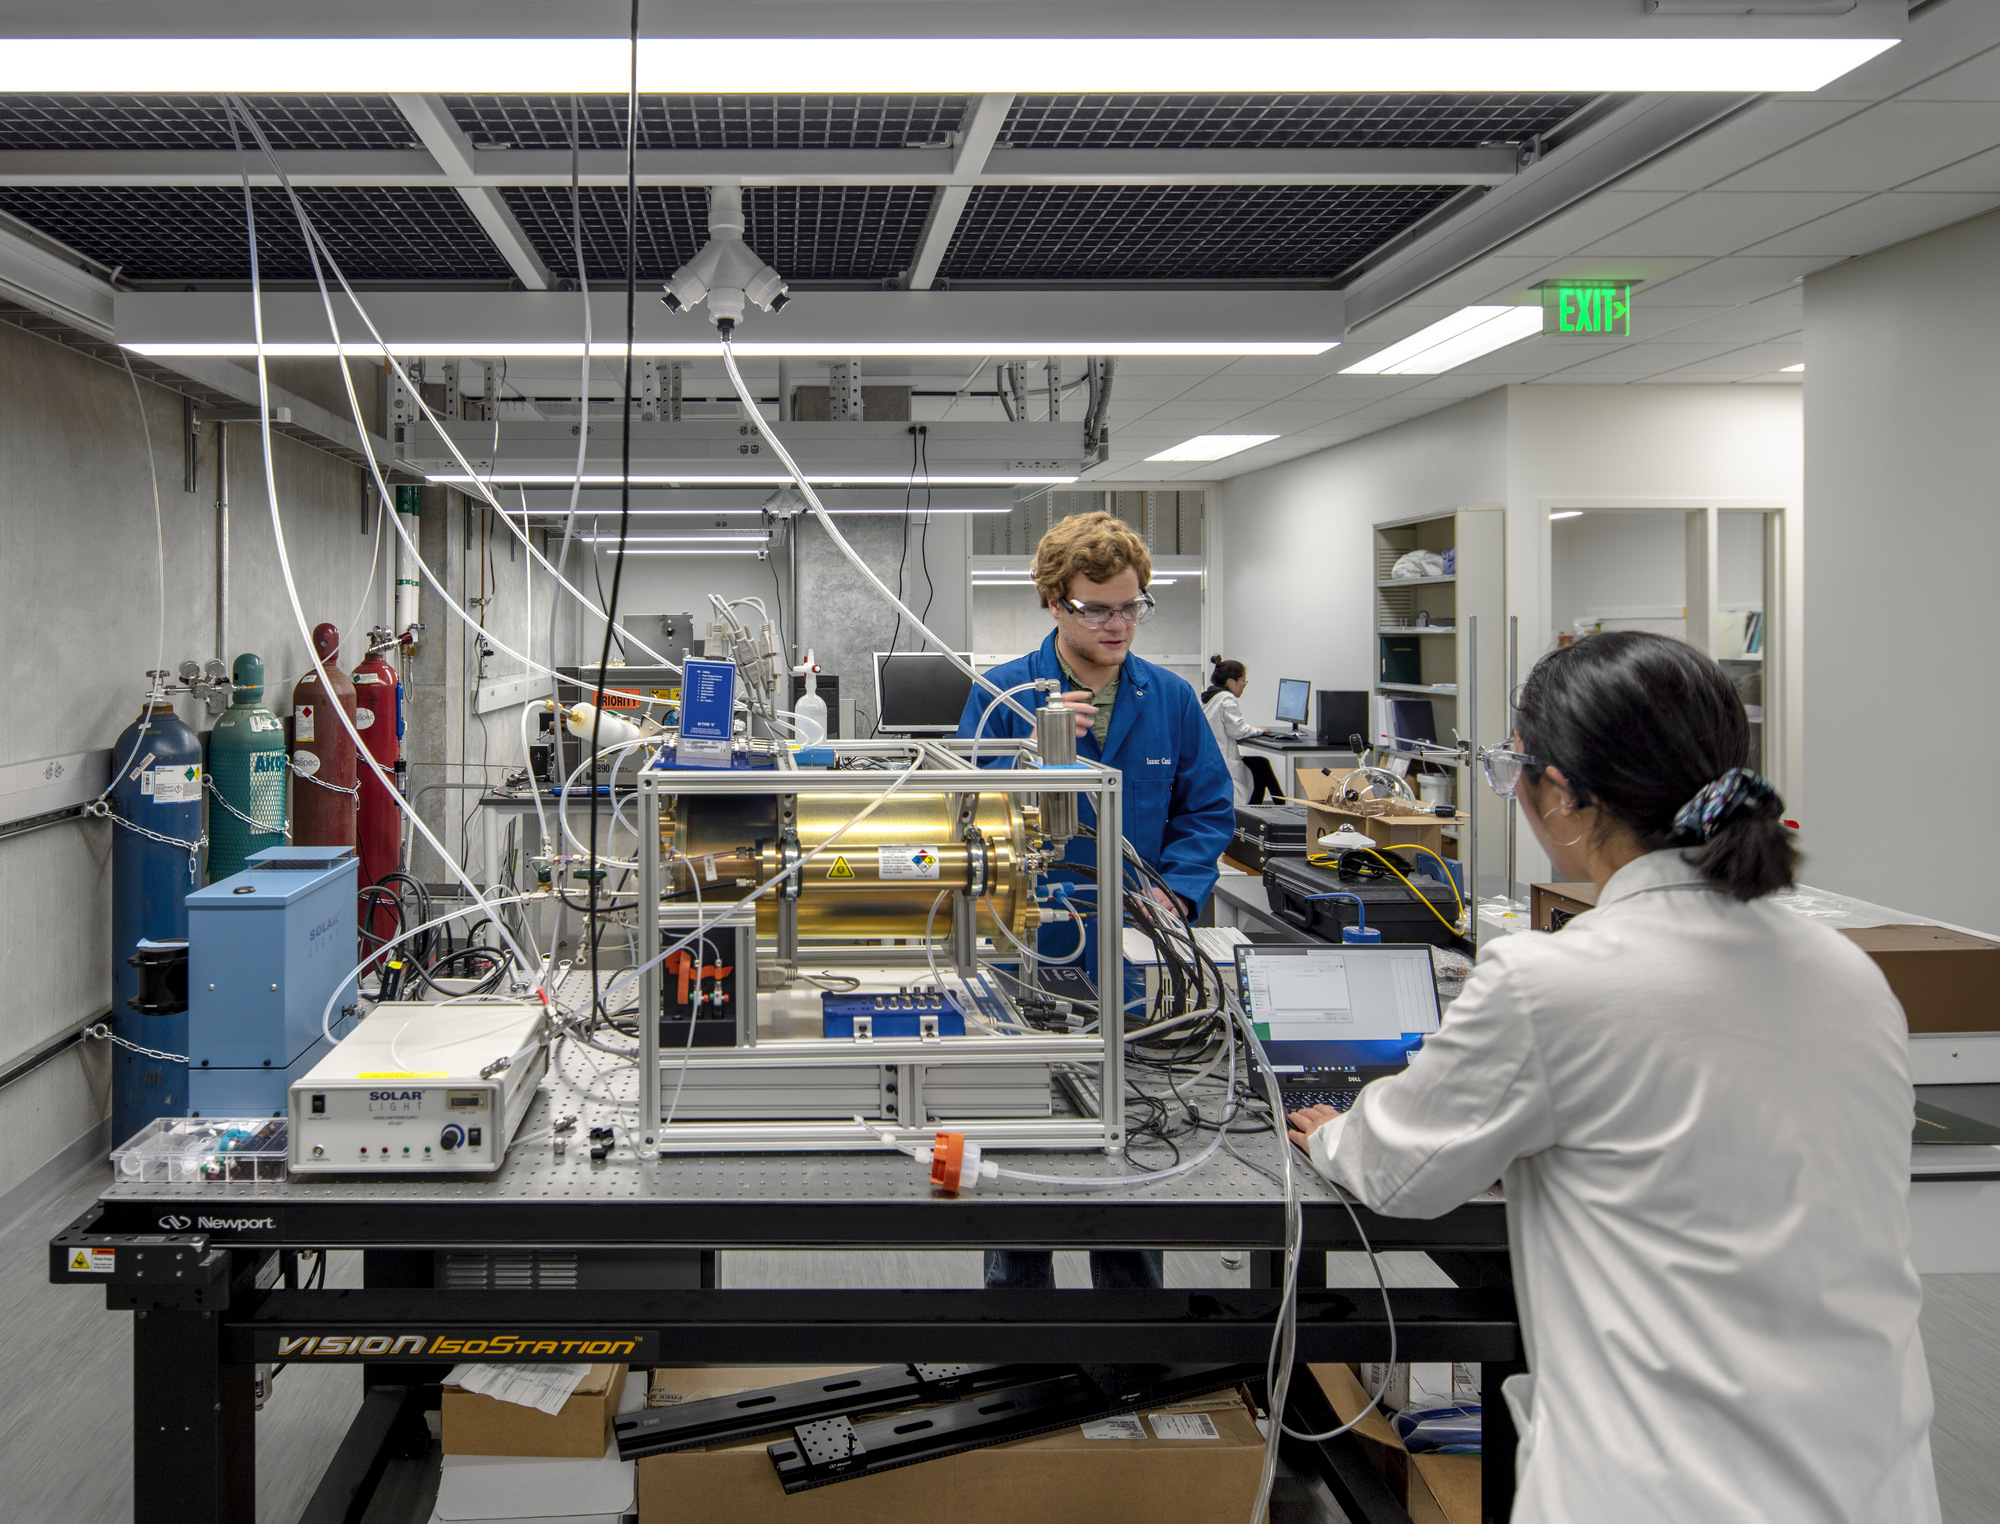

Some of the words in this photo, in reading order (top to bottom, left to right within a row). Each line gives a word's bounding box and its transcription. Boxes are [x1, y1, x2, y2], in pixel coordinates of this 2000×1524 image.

[1560, 288, 1616, 332] EXIT
[597, 696, 637, 706] RIORITY
[1146, 757, 1160, 765] Isaac
[369, 1091, 422, 1101] SOLAR
[369, 1103, 422, 1111] LIGHT
[198, 1216, 273, 1231] Newport
[278, 1336, 427, 1355] VISION
